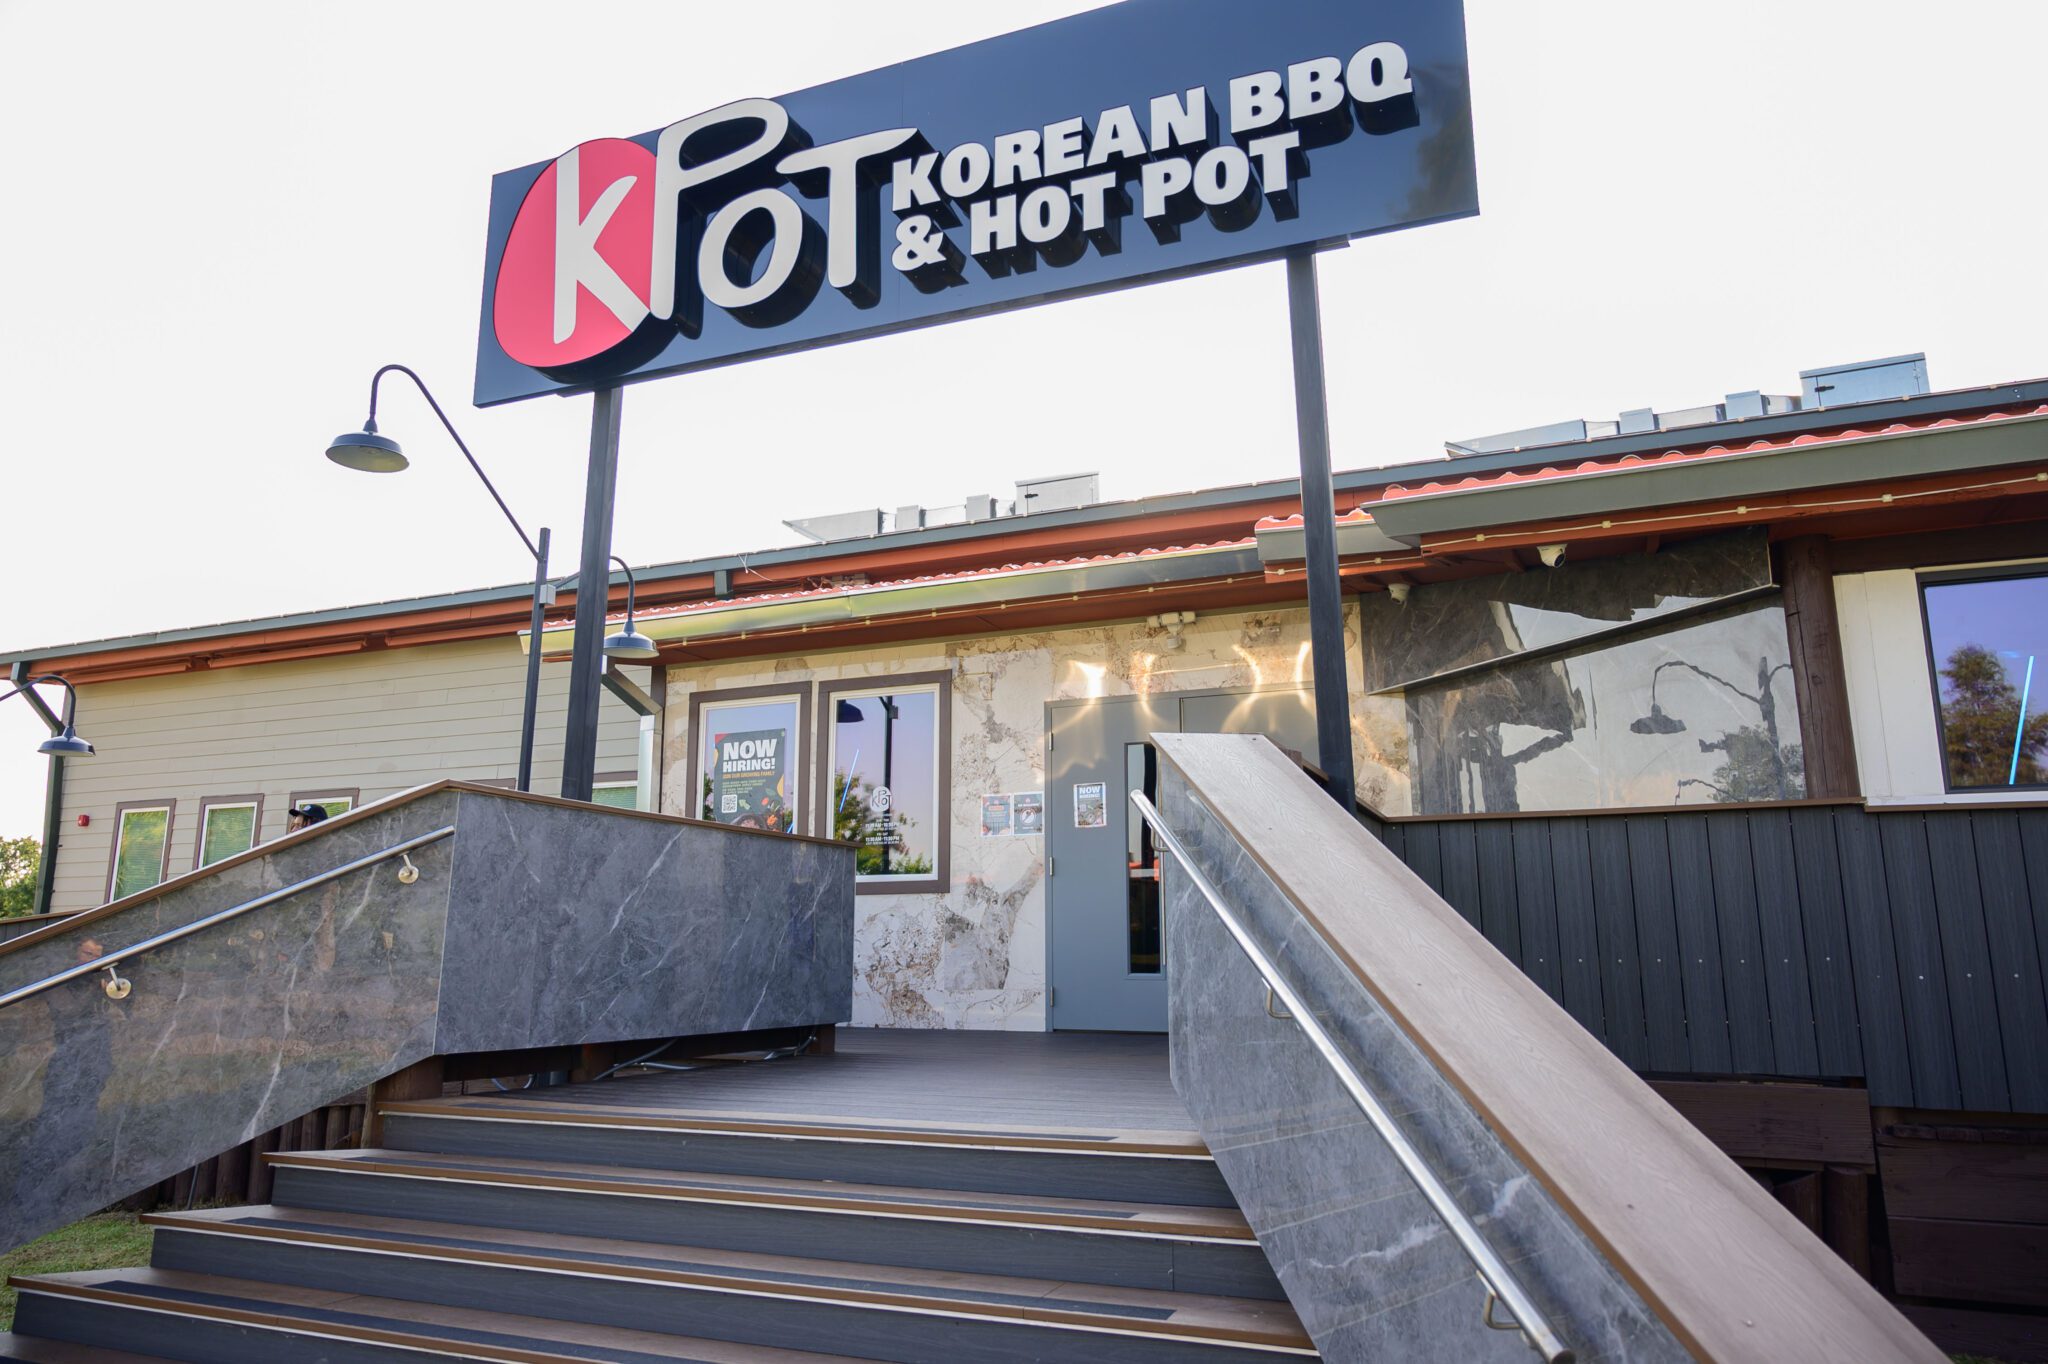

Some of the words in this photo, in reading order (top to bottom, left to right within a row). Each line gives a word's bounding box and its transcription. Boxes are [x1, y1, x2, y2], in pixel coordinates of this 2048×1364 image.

[892, 86, 1207, 211] KOREAN
[1229, 41, 1413, 133] BBQ
[891, 215, 944, 271] &
[970, 172, 1117, 255] HOT
[1142, 131, 1300, 219] POT
[723, 738, 777, 760] NOW
[722, 758, 776, 772] HIRING!
[1079, 786, 1101, 794] NOW
